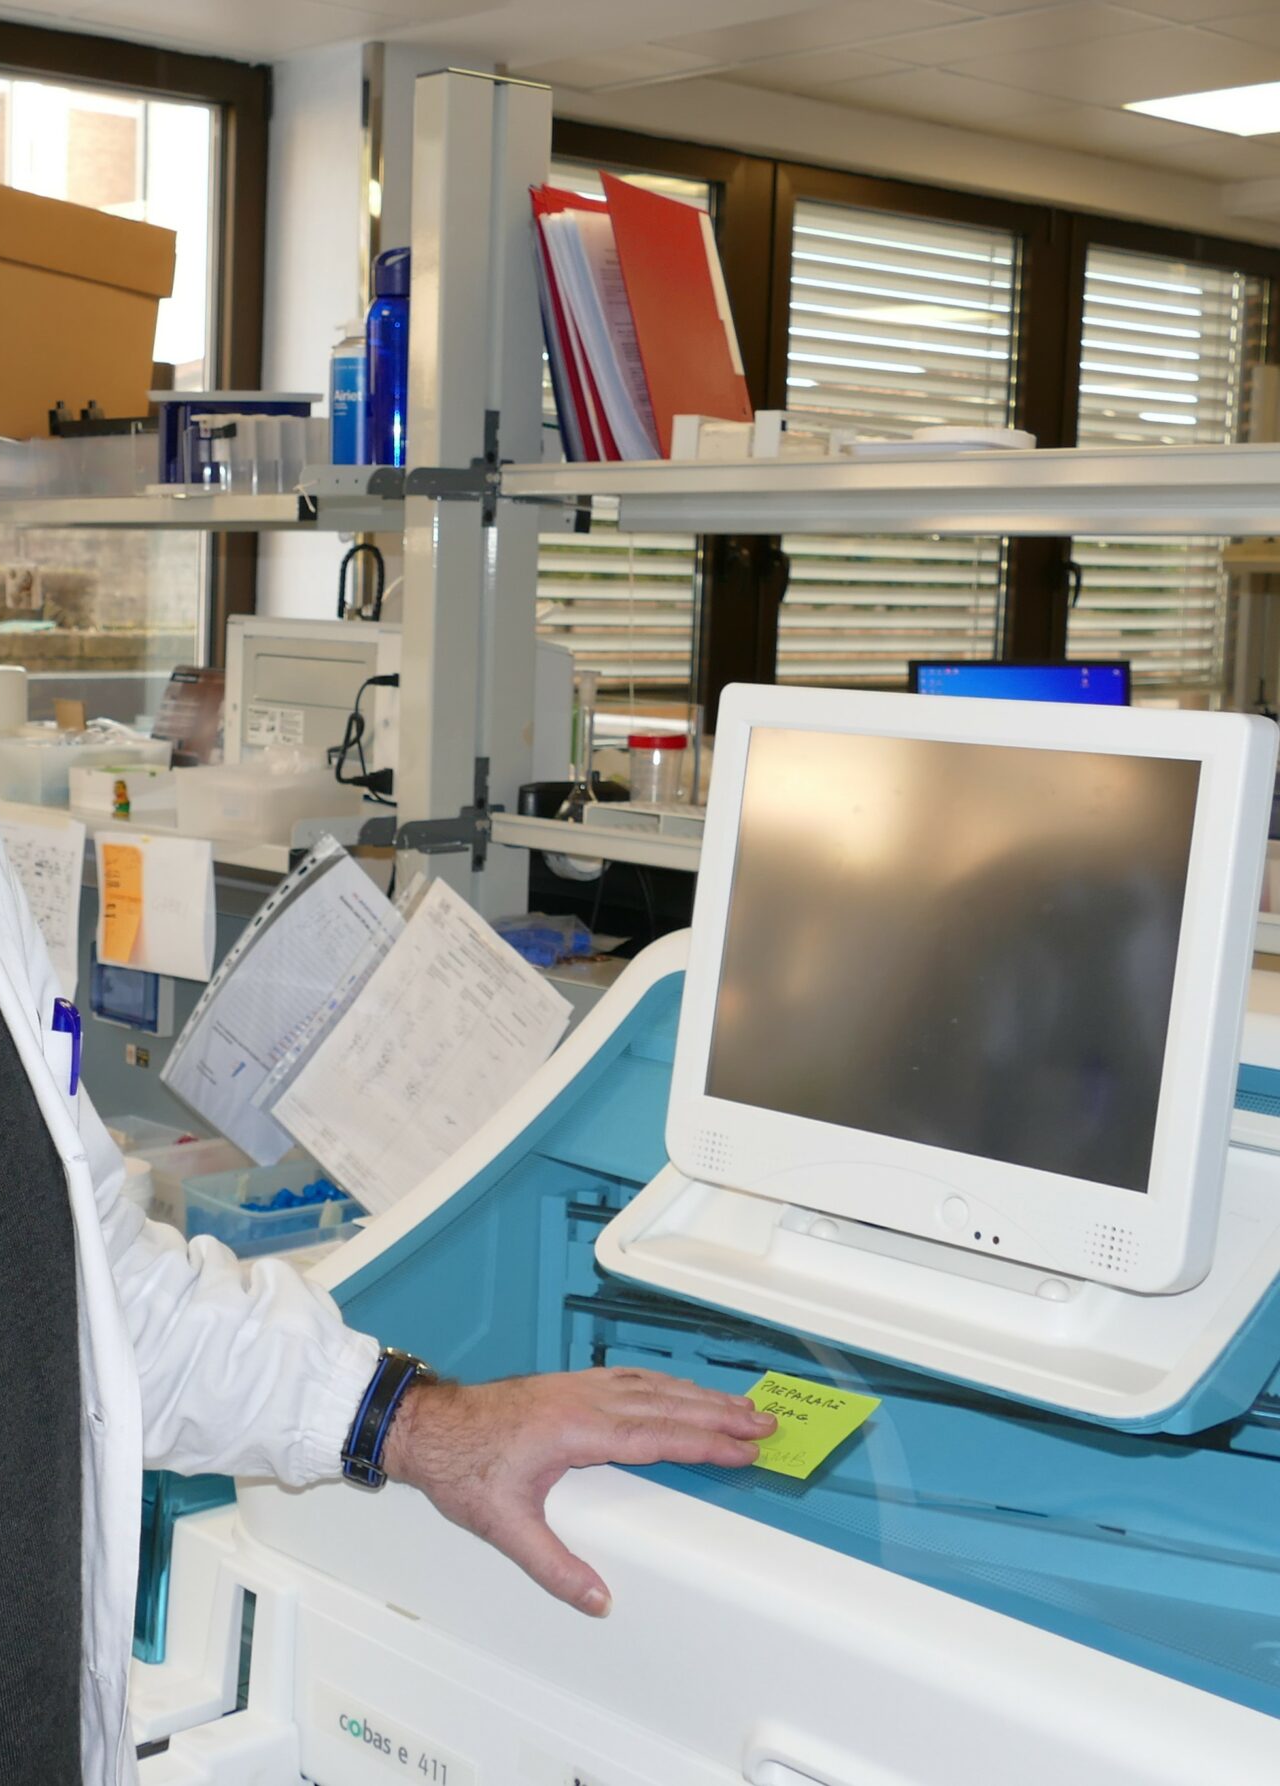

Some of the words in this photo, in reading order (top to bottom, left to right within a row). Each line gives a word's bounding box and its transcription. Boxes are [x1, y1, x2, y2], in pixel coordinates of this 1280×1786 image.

[338, 1713, 391, 1755] cobas
[398, 1745, 408, 1764] e
[417, 1752, 447, 1786] 411
